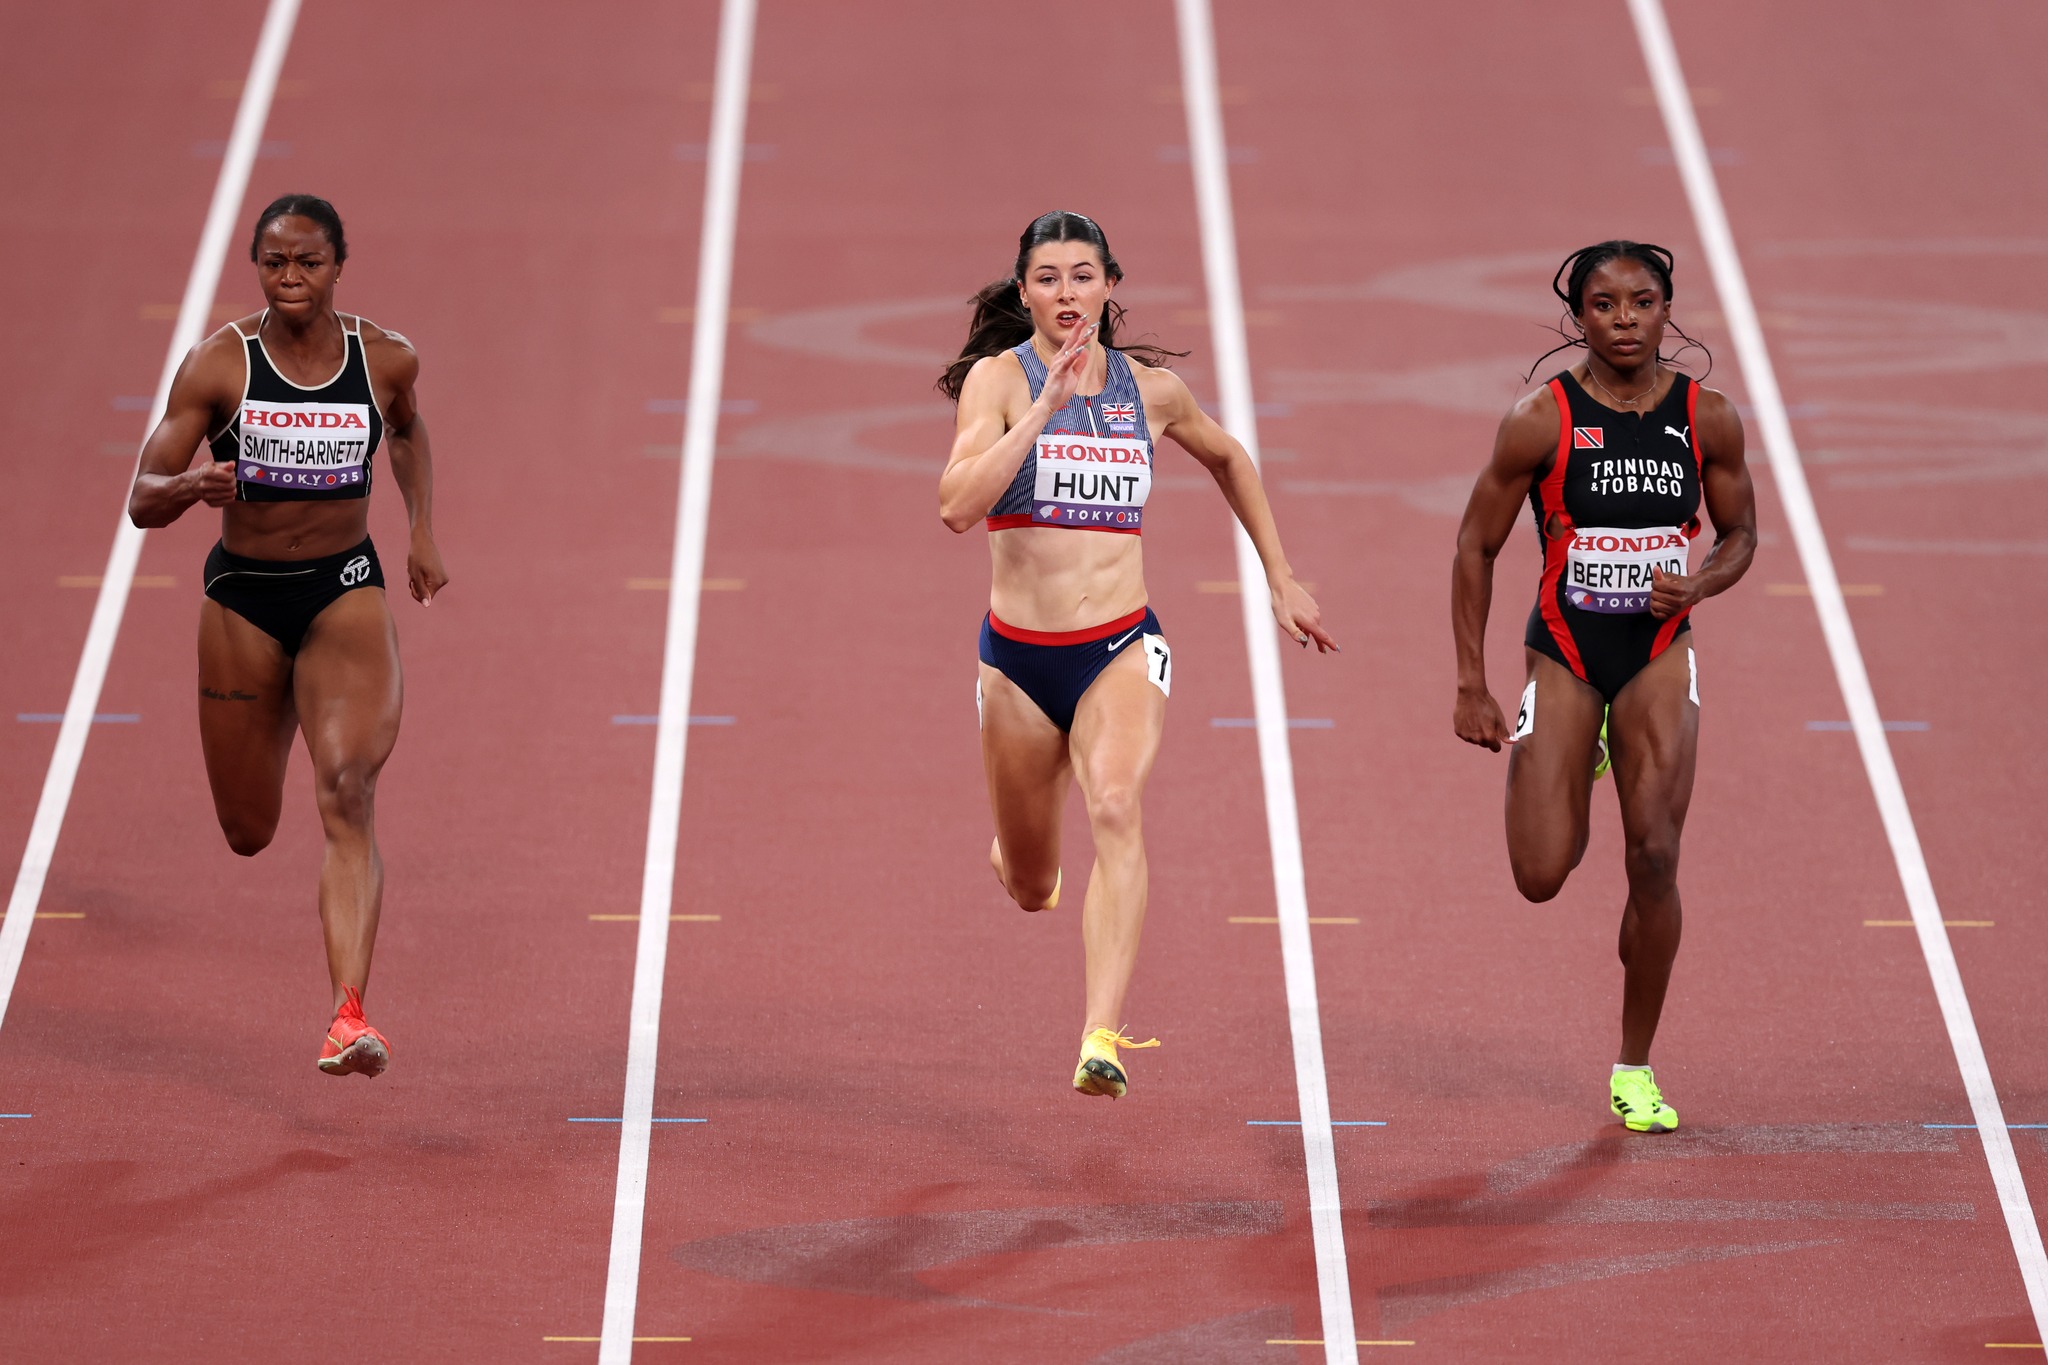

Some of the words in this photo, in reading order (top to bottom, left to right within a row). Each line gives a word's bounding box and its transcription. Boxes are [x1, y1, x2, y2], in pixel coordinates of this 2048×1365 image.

[243, 409, 366, 429] HONDA
[244, 434, 365, 465] SMITH-BARNETT
[1040, 443, 1148, 465] HONDA
[1591, 458, 1684, 480] TRINIDAD
[1053, 472, 1139, 502] HUNT
[1571, 534, 1687, 553] HONDA
[1154, 646, 1168, 682] 7
